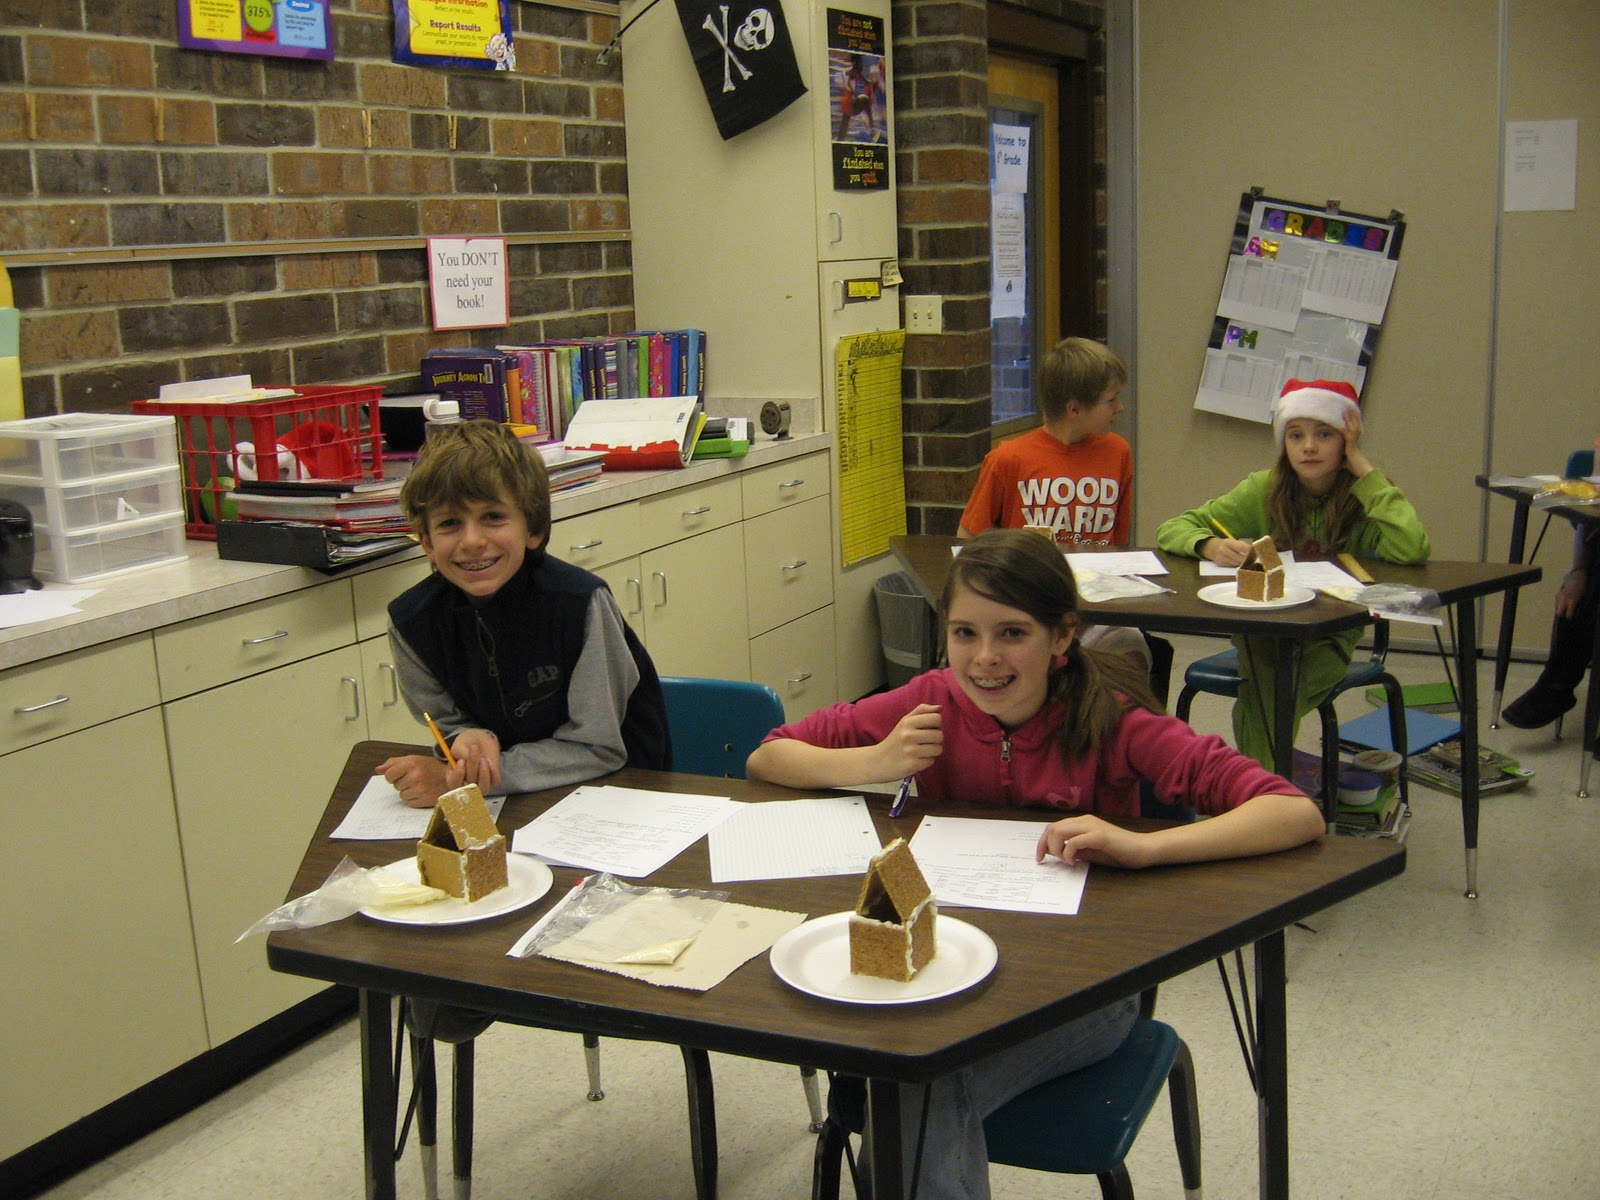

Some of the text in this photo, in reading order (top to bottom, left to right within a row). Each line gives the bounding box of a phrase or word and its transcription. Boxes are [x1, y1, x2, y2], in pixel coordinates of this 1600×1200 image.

[430, 19, 482, 32] Report Results
[1018, 136, 1027, 147] to
[842, 156, 873, 169] finished
[1004, 153, 1021, 166] Grade
[1243, 236, 1280, 261] AM
[438, 252, 499, 267] You DON'T
[446, 273, 494, 291] need your
[456, 294, 485, 309] book!
[1226, 325, 1259, 350] PM
[1017, 476, 1120, 506] WOOD
[1021, 505, 1117, 534] WARD
[527, 664, 559, 688] GAP
